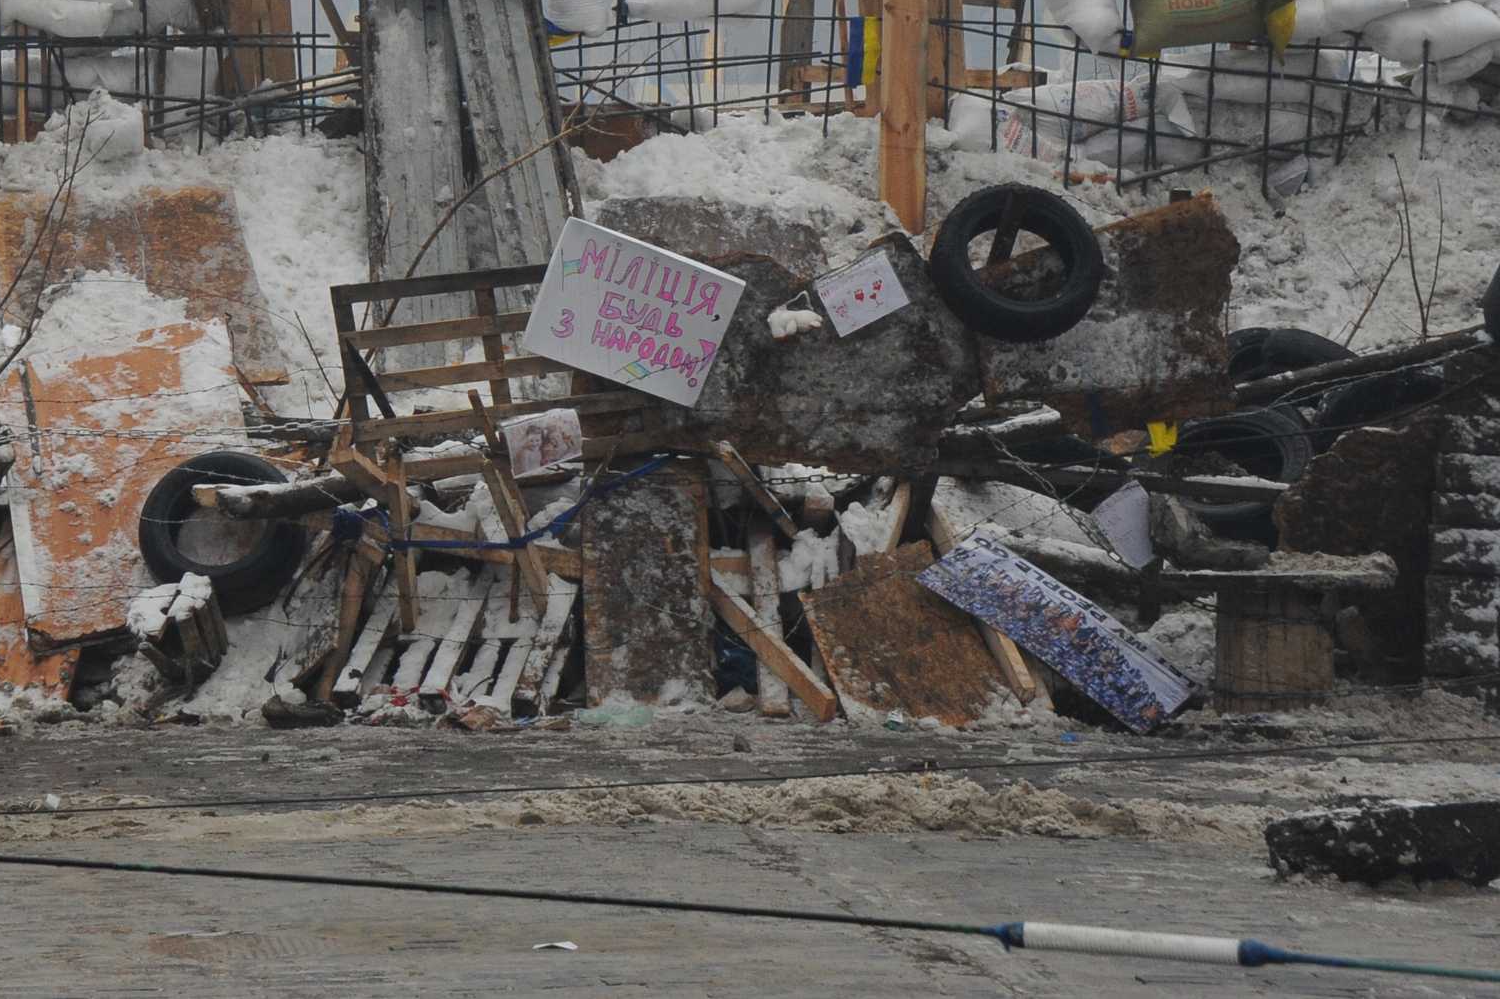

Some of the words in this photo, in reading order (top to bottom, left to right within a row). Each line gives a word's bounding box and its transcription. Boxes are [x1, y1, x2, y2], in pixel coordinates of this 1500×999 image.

[598, 291, 684, 338] БУДЬ
[974, 536, 1010, 559] GO
[1014, 560, 1109, 622] PEOPLE
